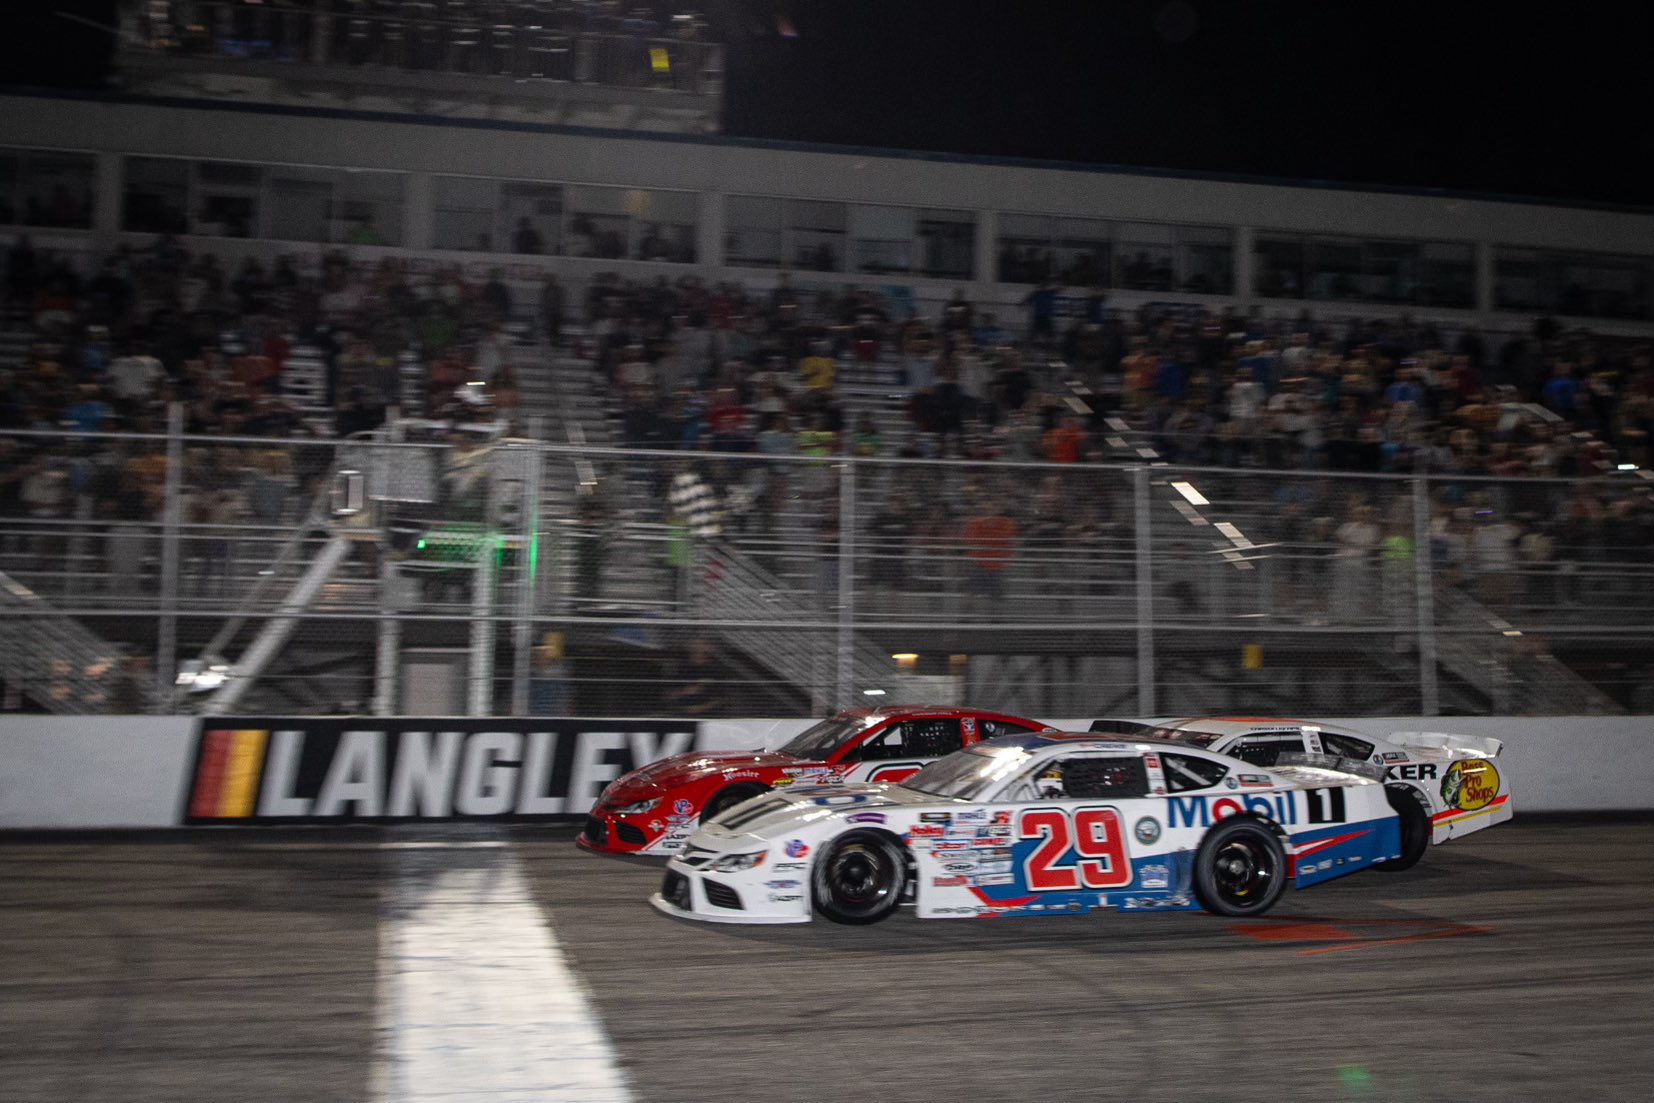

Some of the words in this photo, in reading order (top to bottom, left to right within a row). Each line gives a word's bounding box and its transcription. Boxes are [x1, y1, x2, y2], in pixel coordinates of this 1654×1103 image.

[256, 730, 695, 817] LANGLEY
[723, 770, 760, 781] Hoosier
[1465, 774, 1482, 789] Pro
[1466, 786, 1494, 803] Shops
[1167, 790, 1297, 828] Mobil
[1017, 805, 1134, 892] 29
